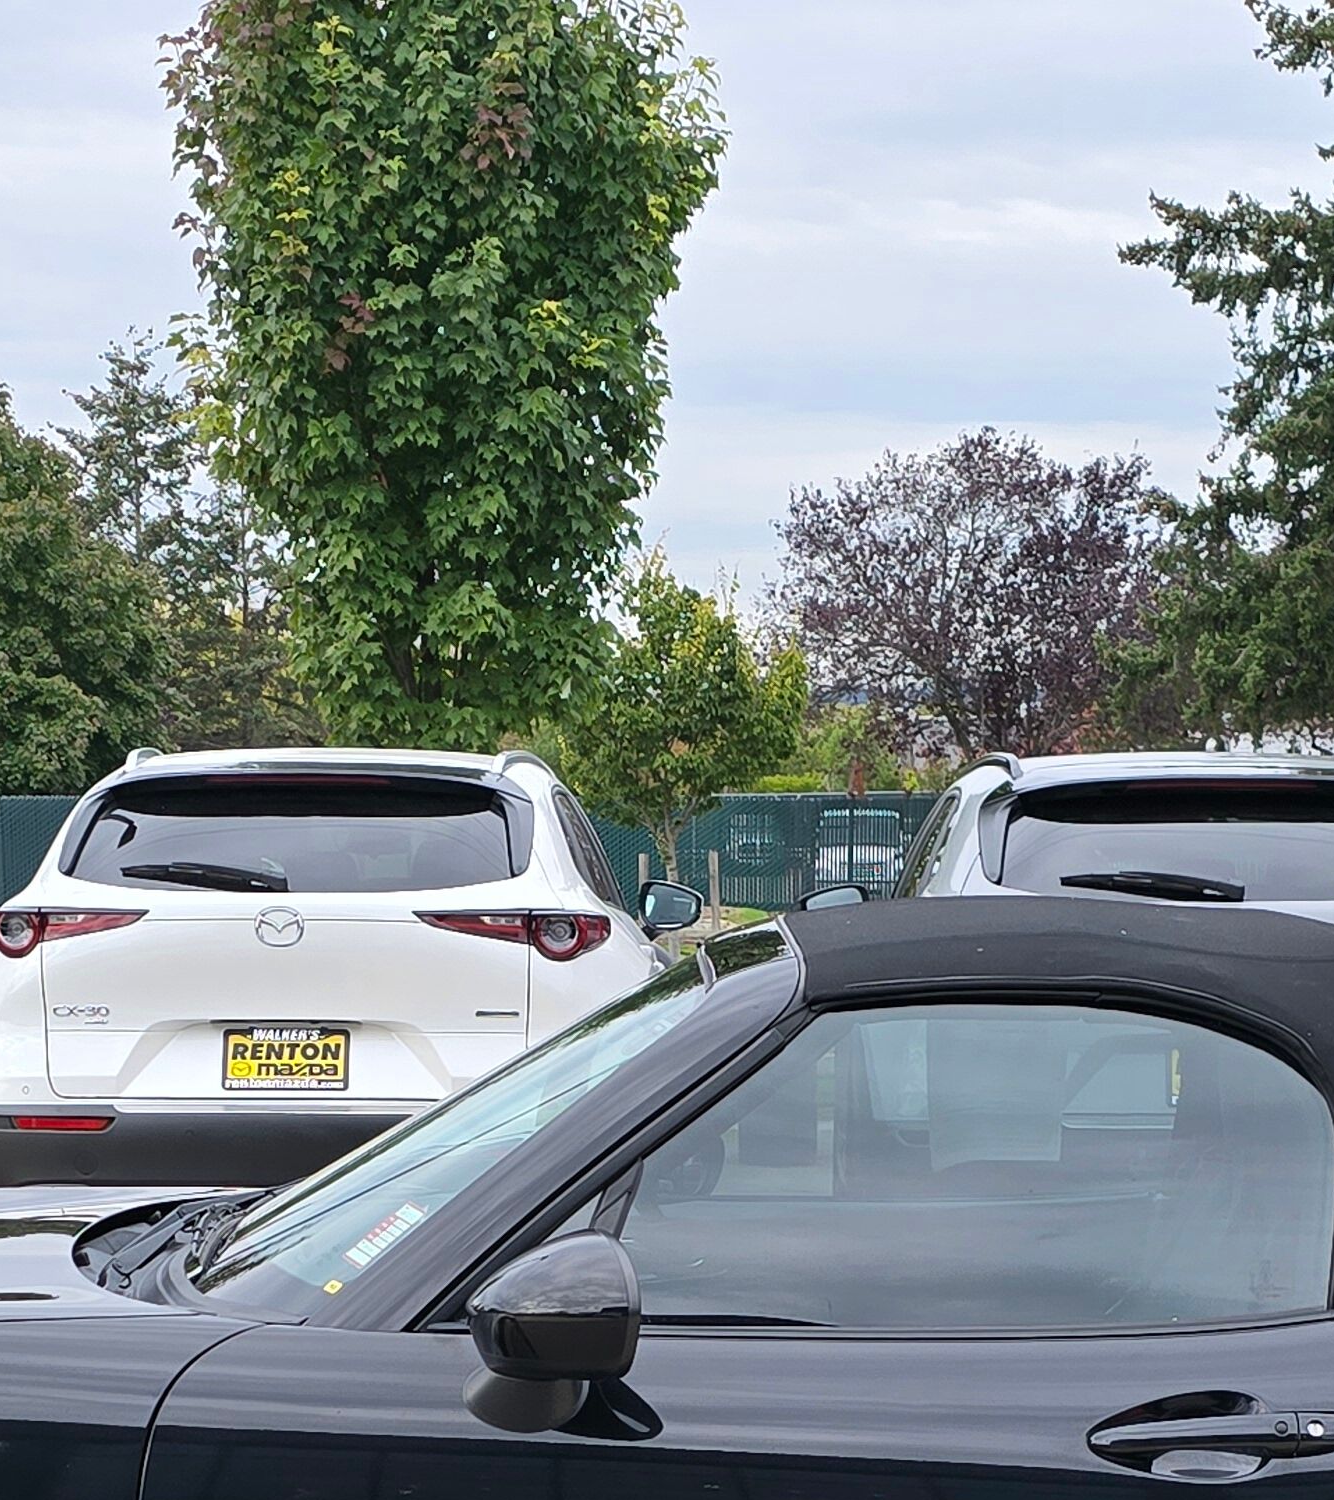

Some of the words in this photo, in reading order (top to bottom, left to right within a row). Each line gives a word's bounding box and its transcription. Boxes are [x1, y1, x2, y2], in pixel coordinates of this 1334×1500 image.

[53, 1005, 109, 1017] CX-30
[252, 1028, 321, 1041] WALKER'S
[232, 1042, 341, 1061] RENTON
